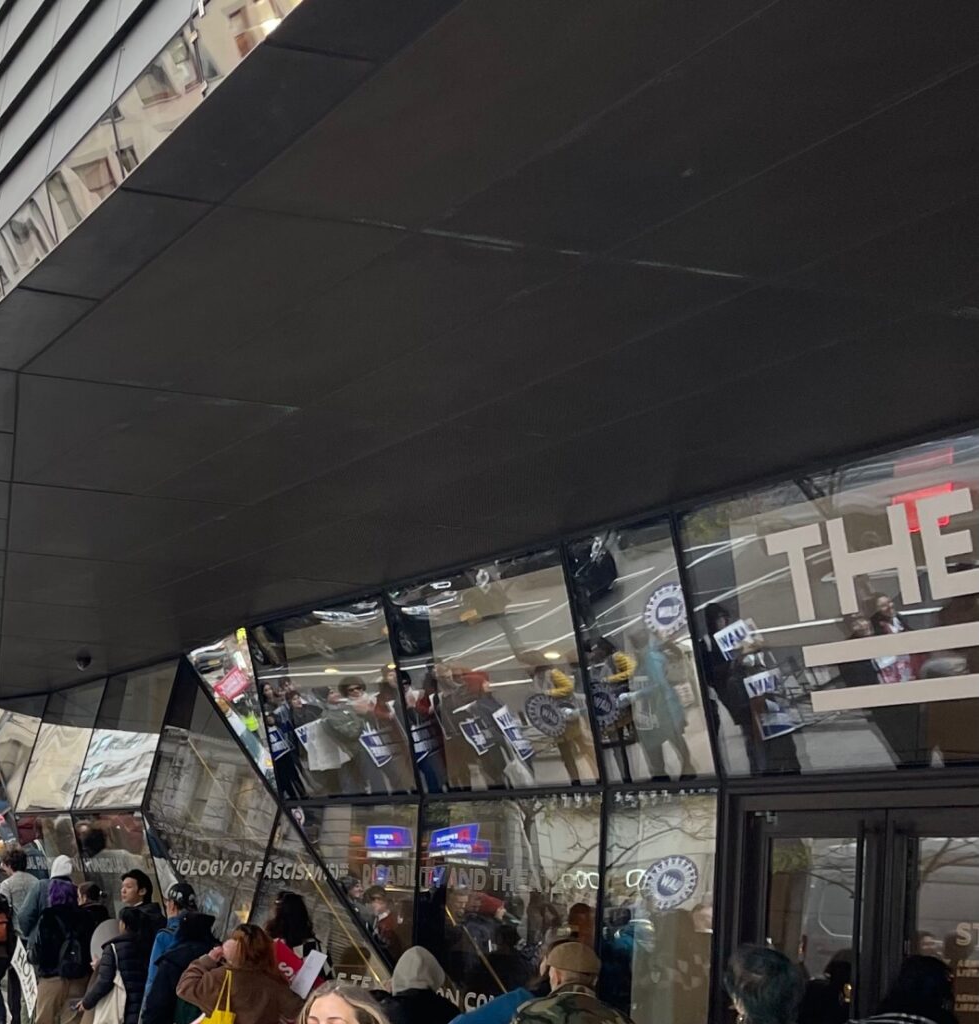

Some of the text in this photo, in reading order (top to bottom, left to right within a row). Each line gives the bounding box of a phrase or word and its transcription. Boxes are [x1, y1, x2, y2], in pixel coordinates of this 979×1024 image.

[765, 487, 979, 622] THE
[172, 859, 229, 876] IOLOGY
[231, 861, 252, 877] OF
[362, 863, 446, 889] DISABILTY
[447, 868, 487, 891] AND
